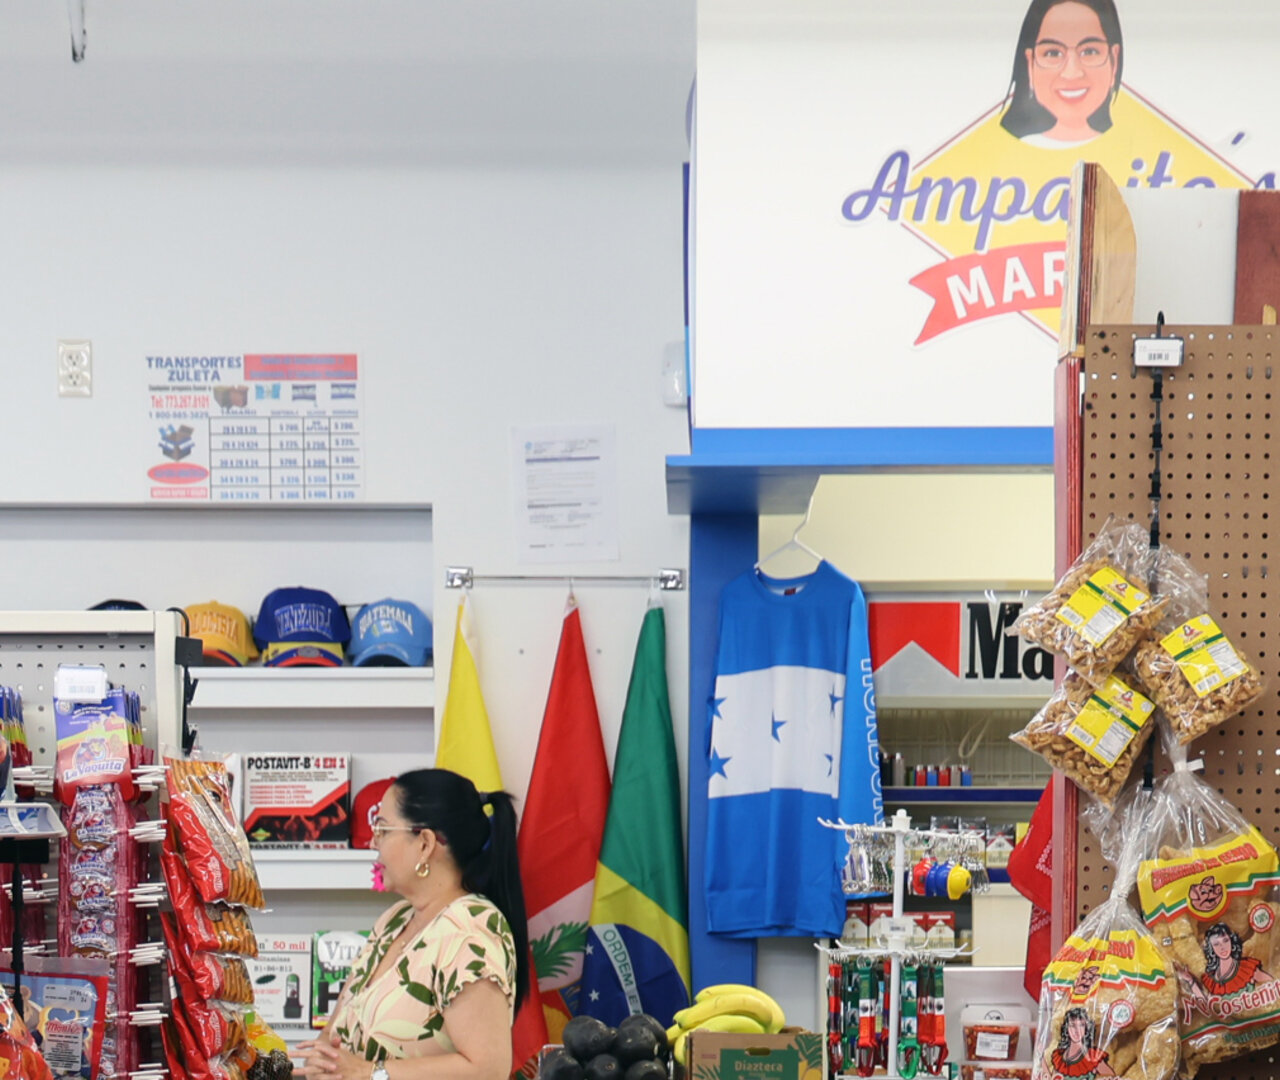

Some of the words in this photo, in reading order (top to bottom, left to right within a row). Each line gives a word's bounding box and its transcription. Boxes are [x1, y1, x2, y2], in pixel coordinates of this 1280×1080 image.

[146, 356, 242, 369] TRANSPORTES
[168, 370, 221, 382] ZULETA
[358, 603, 414, 639] GUATEMALA
[314, 758, 320, 768] 4
[323, 758, 337, 768] EN
[339, 758, 345, 768] 1
[64, 768, 77, 781] La
[77, 759, 124, 777] Vaquita
[273, 941, 286, 949] 50
[289, 941, 306, 949] mil
[603, 929, 633, 986] ORDEM
[735, 1061, 783, 1072] Diazteca
